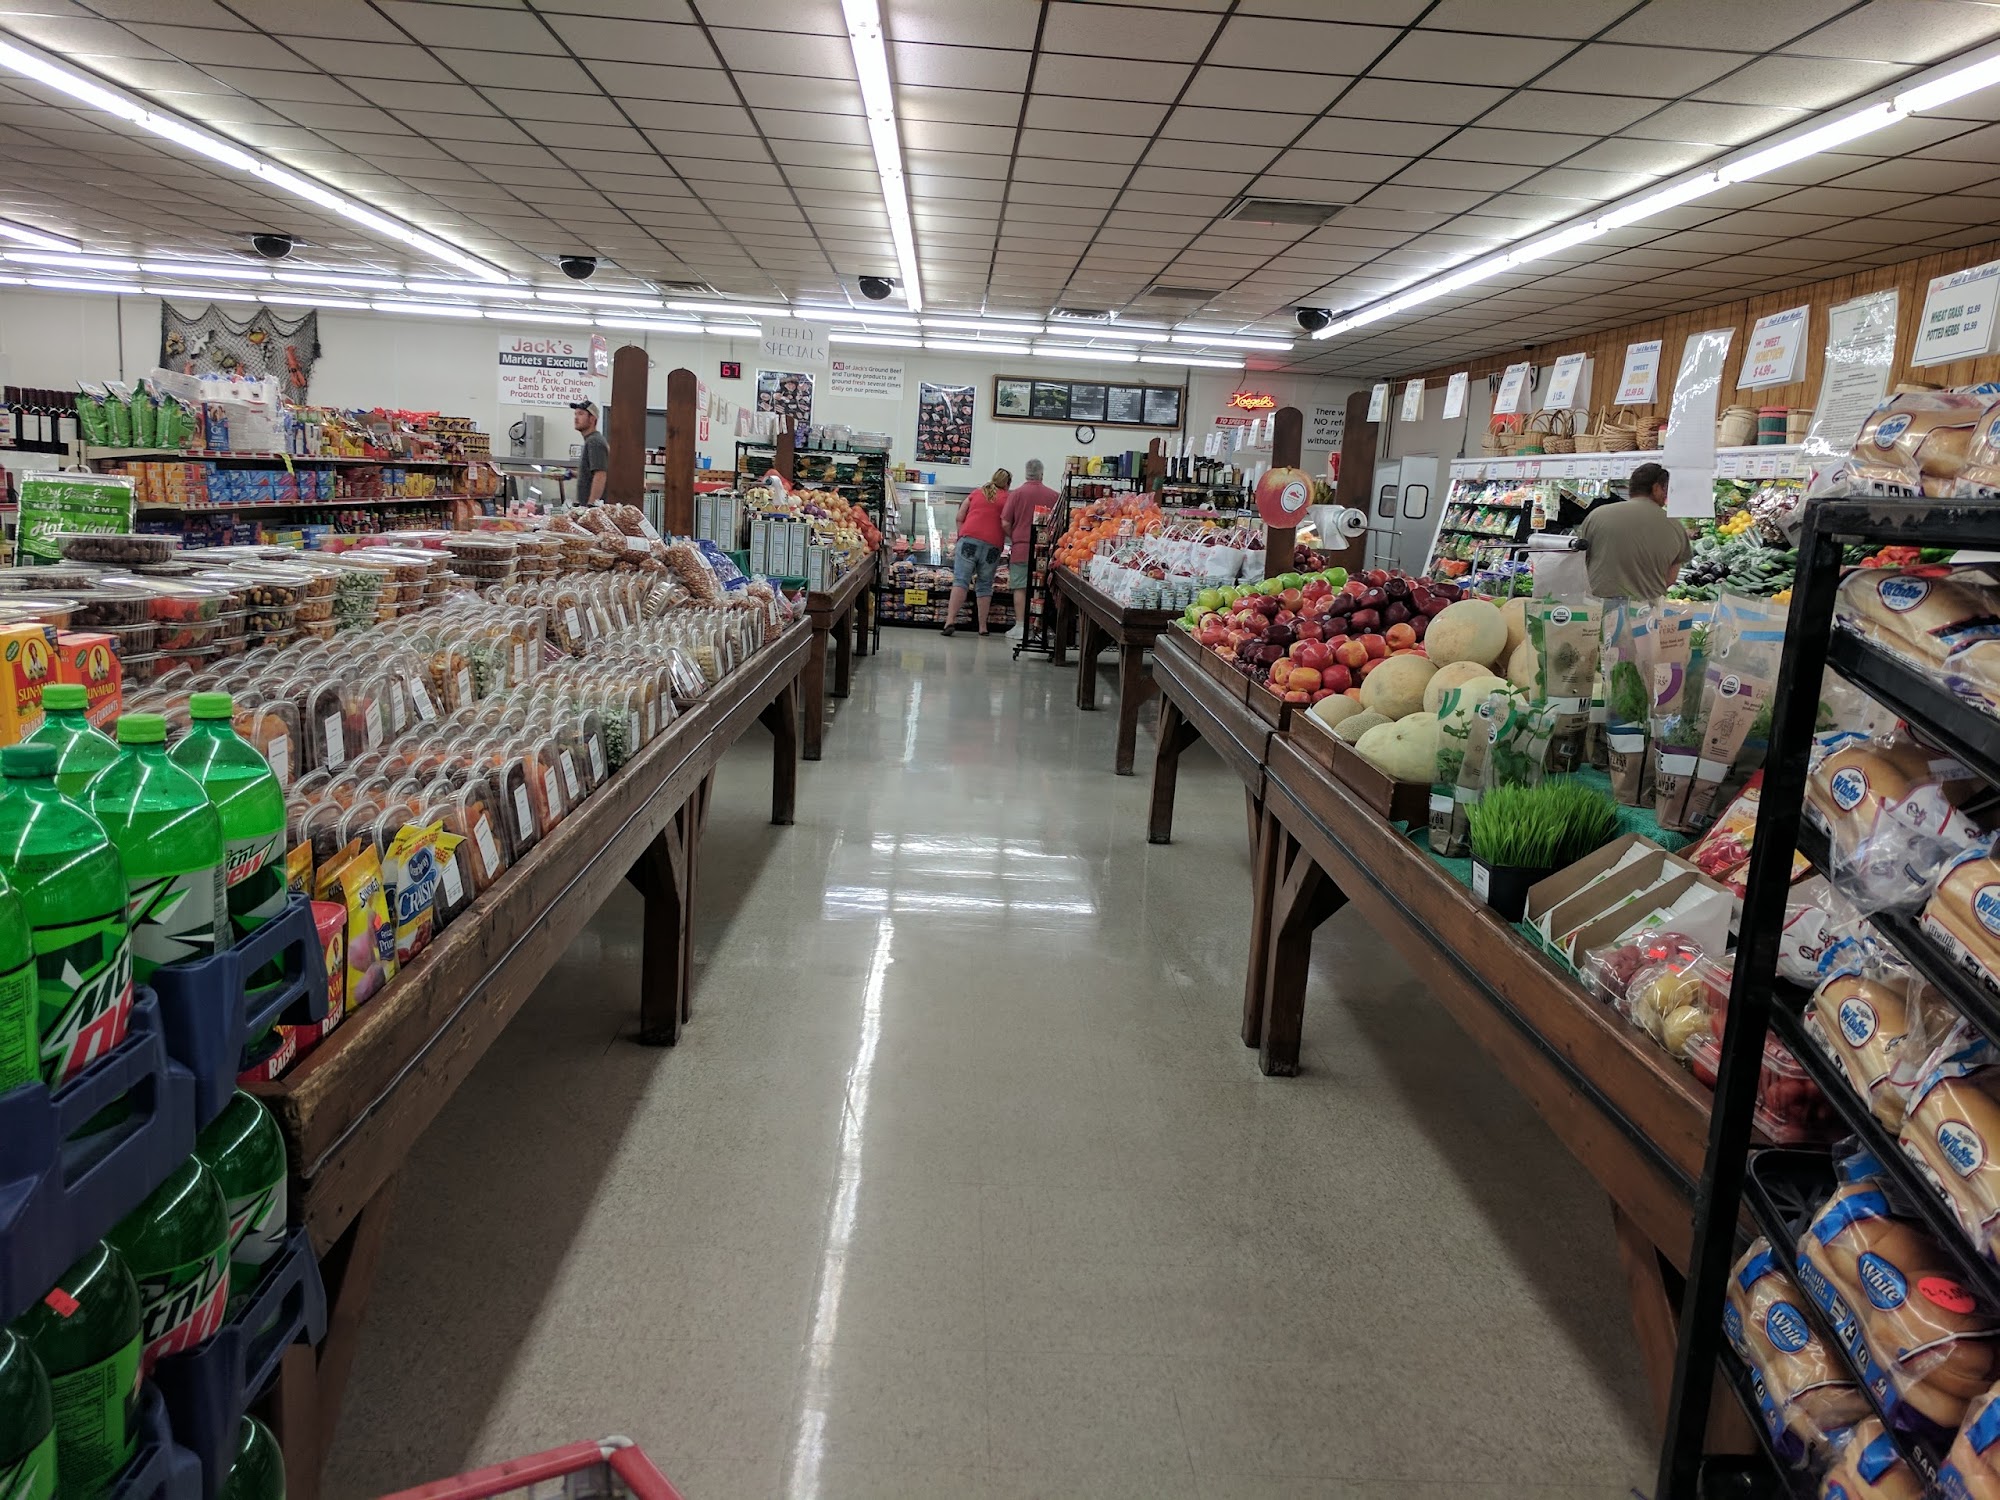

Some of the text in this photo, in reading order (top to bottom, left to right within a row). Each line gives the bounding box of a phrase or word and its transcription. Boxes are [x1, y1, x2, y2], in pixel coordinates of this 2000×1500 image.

[1930, 304, 1981, 323] WHEAT GRASS $2.99
[1926, 321, 1978, 342] POTTED HERBS $2.99
[512, 338, 573, 355] Jack's
[1763, 336, 1781, 348] SWEET
[764, 341, 825, 360] SPECIALS
[502, 354, 542, 366] Markets
[833, 362, 844, 370] All
[536, 369, 552, 377] ALL
[722, 365, 739, 377] 67
[1632, 364, 1649, 372] SWEET
[519, 376, 537, 384] Beef,
[541, 377, 560, 385] Pork,
[563, 379, 596, 387] Chicken,
[831, 378, 852, 386] ground
[843, 371, 862, 380] Turkey
[862, 373, 887, 381] products
[510, 390, 544, 399] Products
[1228, 392, 1275, 409] Koegel's
[1316, 408, 1336, 416] There
[1314, 418, 1328, 426] NO
[1326, 429, 1339, 437] any
[33, 502, 119, 514] KEEPS ITEMS
[30, 517, 65, 538] Hot
[1939, 1128, 1976, 1168] White
[1861, 1260, 1901, 1301] White
[1771, 1310, 1803, 1347] White
[1912, 1445, 1938, 1484] SAR
